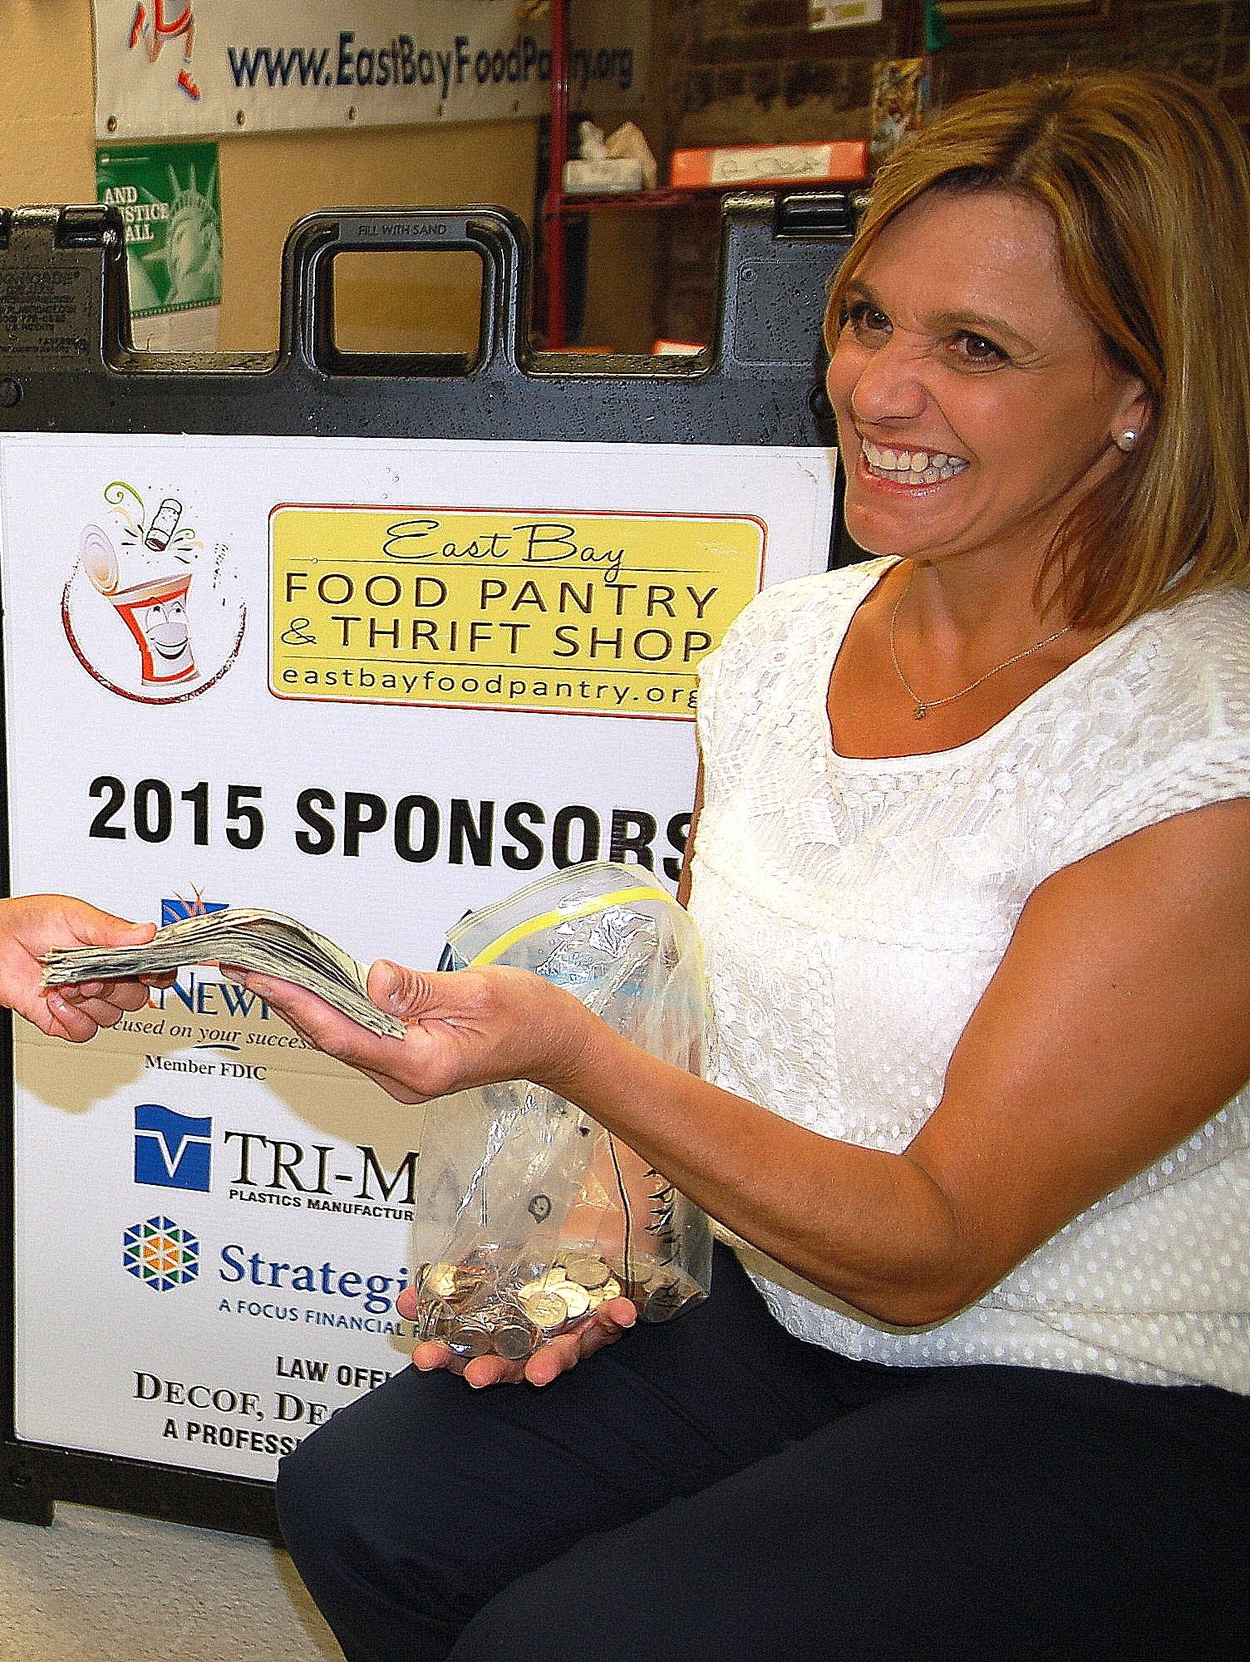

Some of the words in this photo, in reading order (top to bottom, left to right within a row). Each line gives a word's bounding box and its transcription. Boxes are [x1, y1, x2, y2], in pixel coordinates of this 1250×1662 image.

[227, 30, 634, 100] www.EastBayFoodPary.org
[104, 185, 138, 204] AND
[125, 223, 155, 242] ALL
[358, 225, 380, 236] FILL
[382, 224, 411, 236] WITH
[413, 223, 447, 235] SAND
[383, 519, 512, 560] East
[513, 523, 625, 584] Bay
[285, 572, 448, 608] FOOD
[481, 578, 719, 619] PANTRY
[281, 618, 317, 645] &
[331, 615, 531, 654] THRIFT
[553, 625, 713, 663] SHOP
[282, 667, 699, 710] eastbayfoodpantry.org
[88, 775, 265, 851] 2015
[295, 787, 694, 882] SPONSORS
[169, 1024, 193, 1038] on
[198, 1026, 243, 1043] your
[145, 1054, 216, 1076] Member
[220, 1062, 268, 1081] FDIC
[223, 1130, 420, 1204] TRI-M
[229, 1188, 302, 1208] PLASTICS
[306, 1198, 416, 1221] MANUFACTUR
[218, 1244, 410, 1314] Strategi
[218, 1298, 232, 1313] A
[237, 1299, 300, 1322] FOCUS
[305, 1309, 407, 1338] FINANCIAL
[276, 1355, 330, 1383] LAW
[162, 1418, 179, 1440] A
